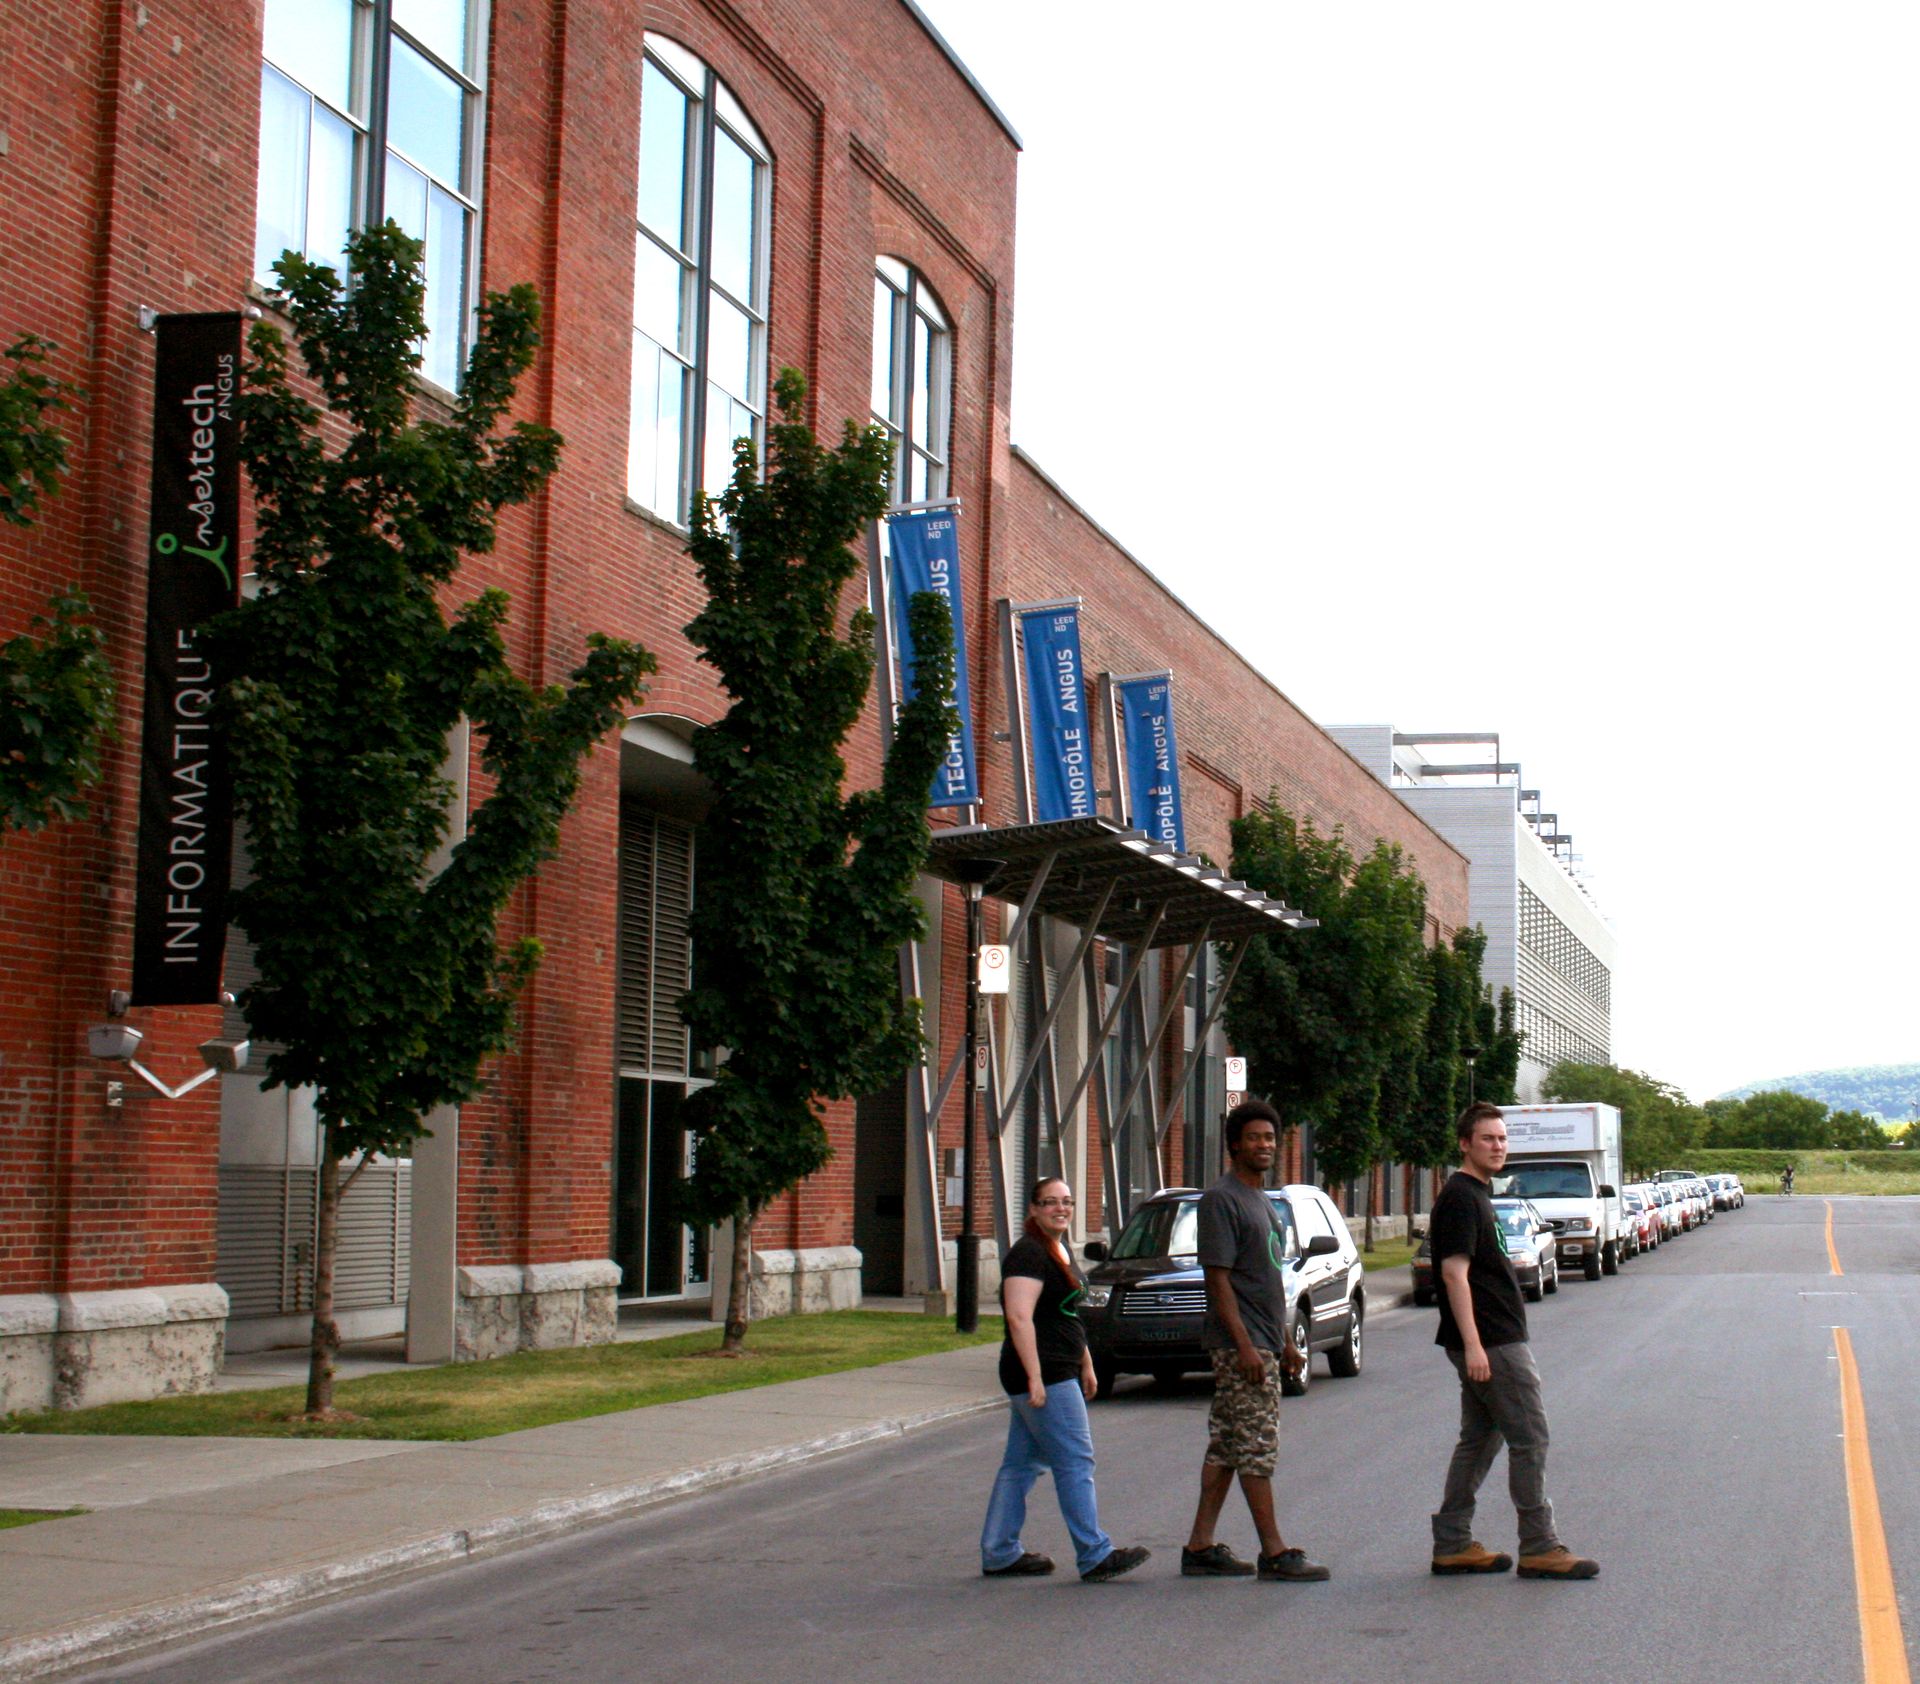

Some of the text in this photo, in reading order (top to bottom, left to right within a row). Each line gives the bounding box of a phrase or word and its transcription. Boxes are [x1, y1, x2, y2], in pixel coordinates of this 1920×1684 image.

[218, 354, 233, 421] ANGUS
[927, 521, 951, 530] LEED
[928, 531, 941, 539] ND
[1054, 616, 1074, 624] LEED
[1054, 624, 1066, 632] ND
[1058, 649, 1078, 713] ANGUS
[1152, 715, 1170, 771] ANGUS
